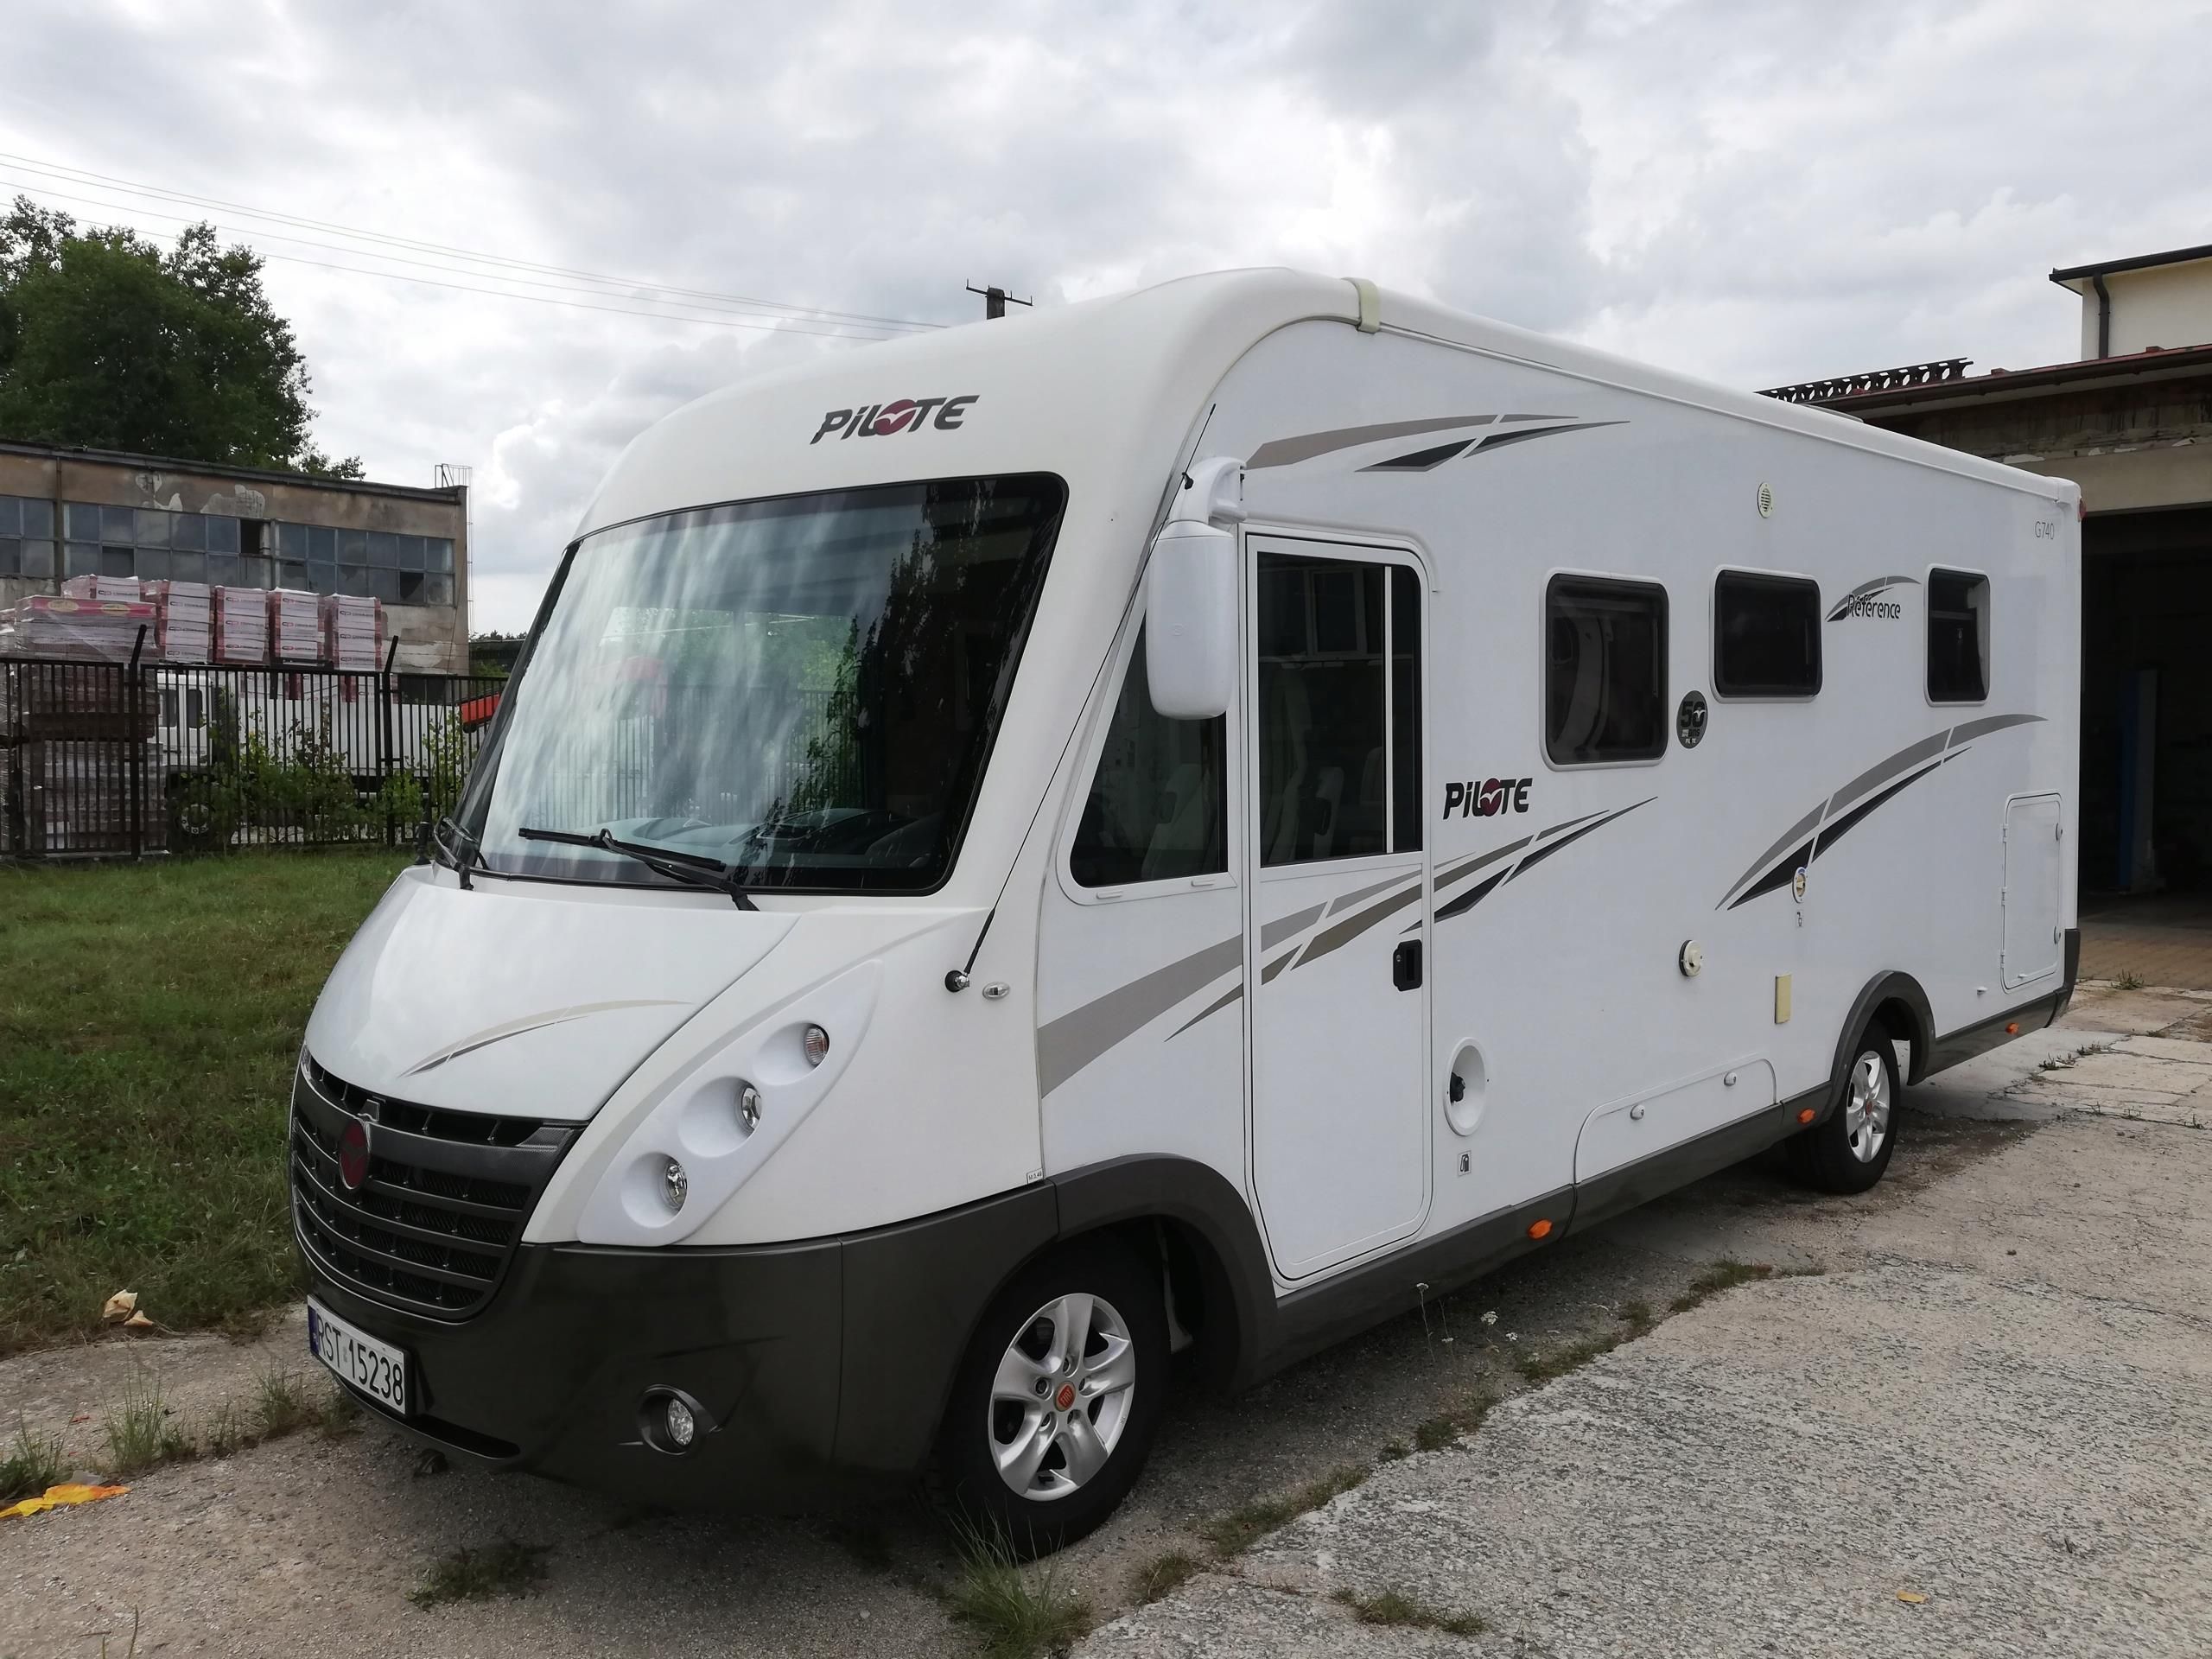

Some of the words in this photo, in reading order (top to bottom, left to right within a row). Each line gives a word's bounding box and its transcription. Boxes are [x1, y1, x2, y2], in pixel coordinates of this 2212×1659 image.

[2034, 520, 2055, 540] G740
[1680, 701, 1707, 728] 50
[316, 1313, 341, 1370] RST
[349, 1338, 404, 1406] 15238
